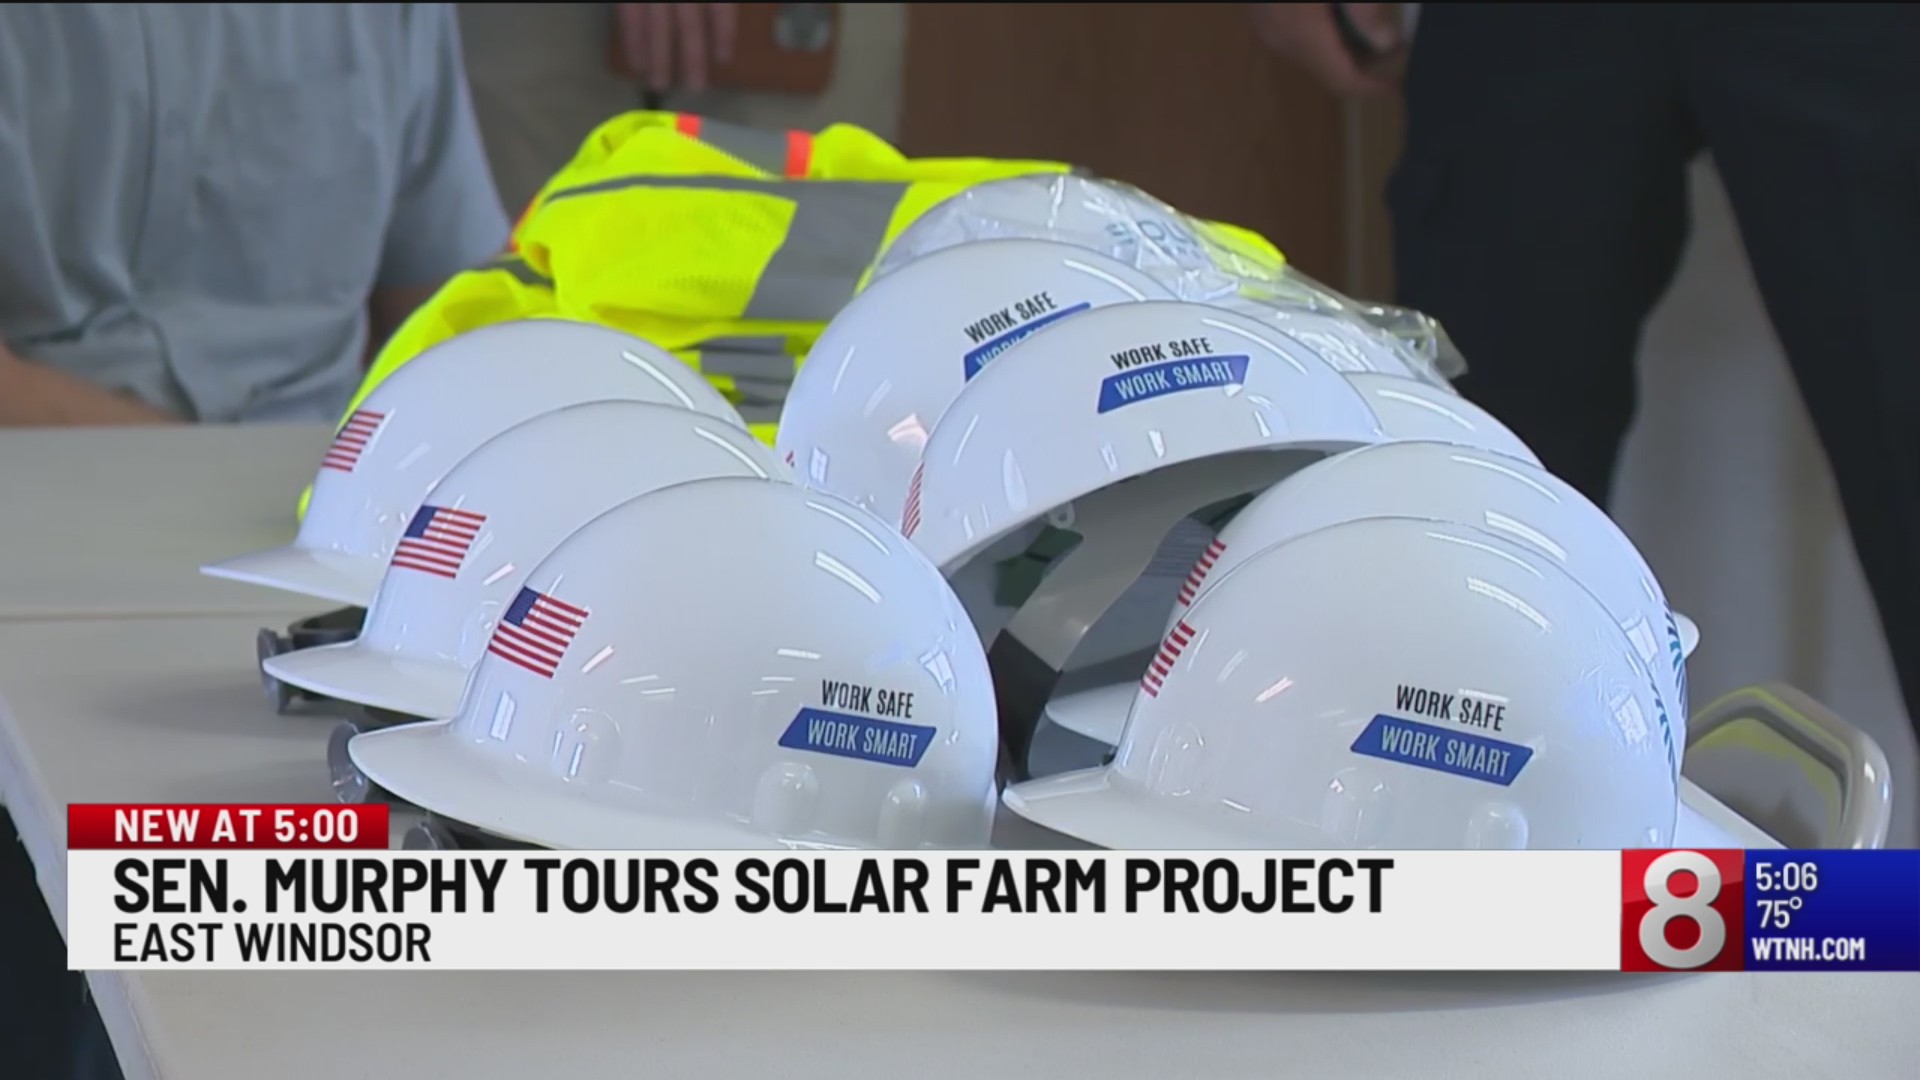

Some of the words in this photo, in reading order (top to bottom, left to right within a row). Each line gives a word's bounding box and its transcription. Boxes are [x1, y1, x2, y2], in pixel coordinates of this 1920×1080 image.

[964, 307, 1018, 344] WORK
[1014, 291, 1057, 321] SAFE
[1110, 343, 1167, 370] WORK
[1168, 337, 1214, 357] SAFE
[1114, 369, 1171, 400] WORK
[1172, 361, 1235, 385] SMART
[822, 679, 872, 713] WORK
[876, 689, 914, 719] SAFE
[1396, 684, 1454, 720] WORK
[1459, 697, 1506, 731] SAFE
[808, 718, 860, 751] WORK
[863, 727, 918, 759] SMART
[1381, 724, 1440, 761] WORK
[1444, 739, 1511, 777] SMART
